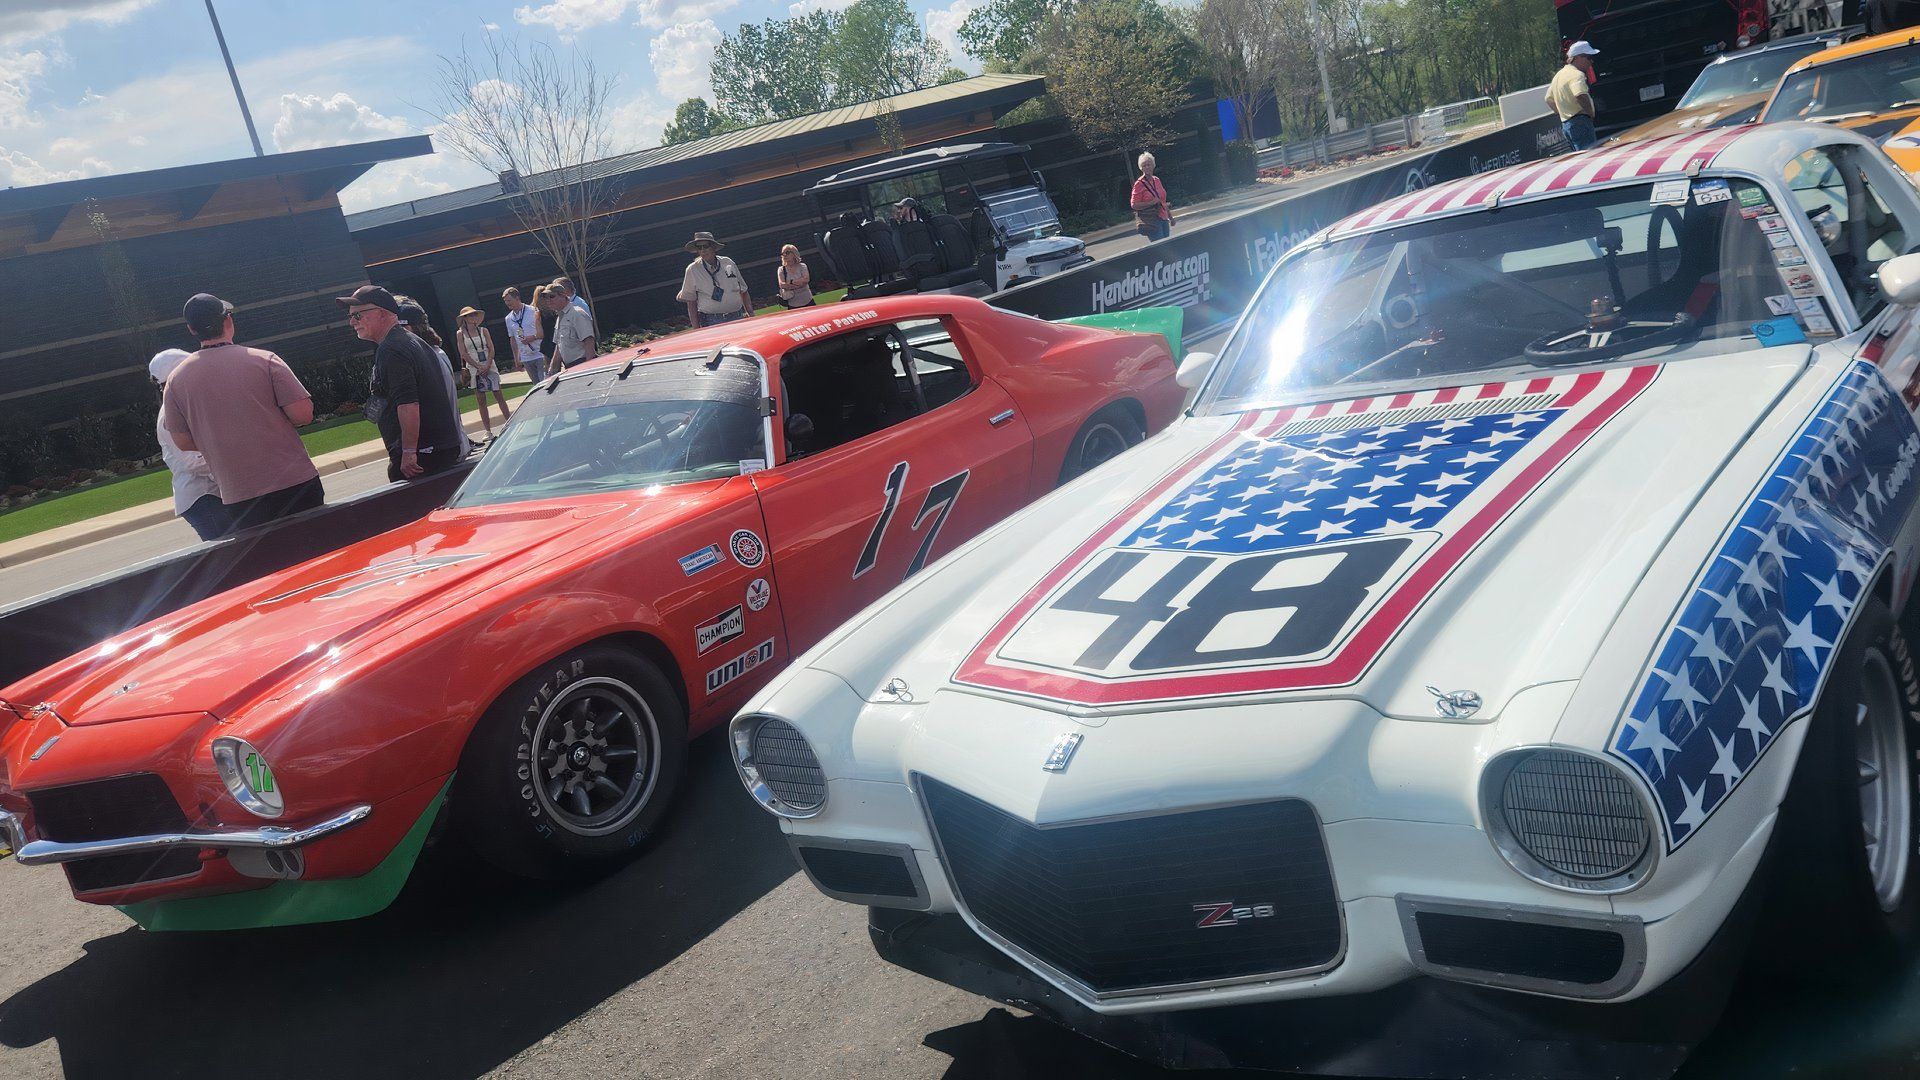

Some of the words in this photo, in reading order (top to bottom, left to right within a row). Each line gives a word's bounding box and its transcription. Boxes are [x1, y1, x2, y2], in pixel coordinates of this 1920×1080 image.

[1480, 149, 1521, 173] HERITAGE
[789, 322, 832, 342] Walter
[853, 460, 970, 583] 17
[1049, 537, 1413, 671] 48
[700, 615, 741, 645] CHAMPION
[246, 752, 274, 793] 17
[1192, 902, 1275, 929] Z28
